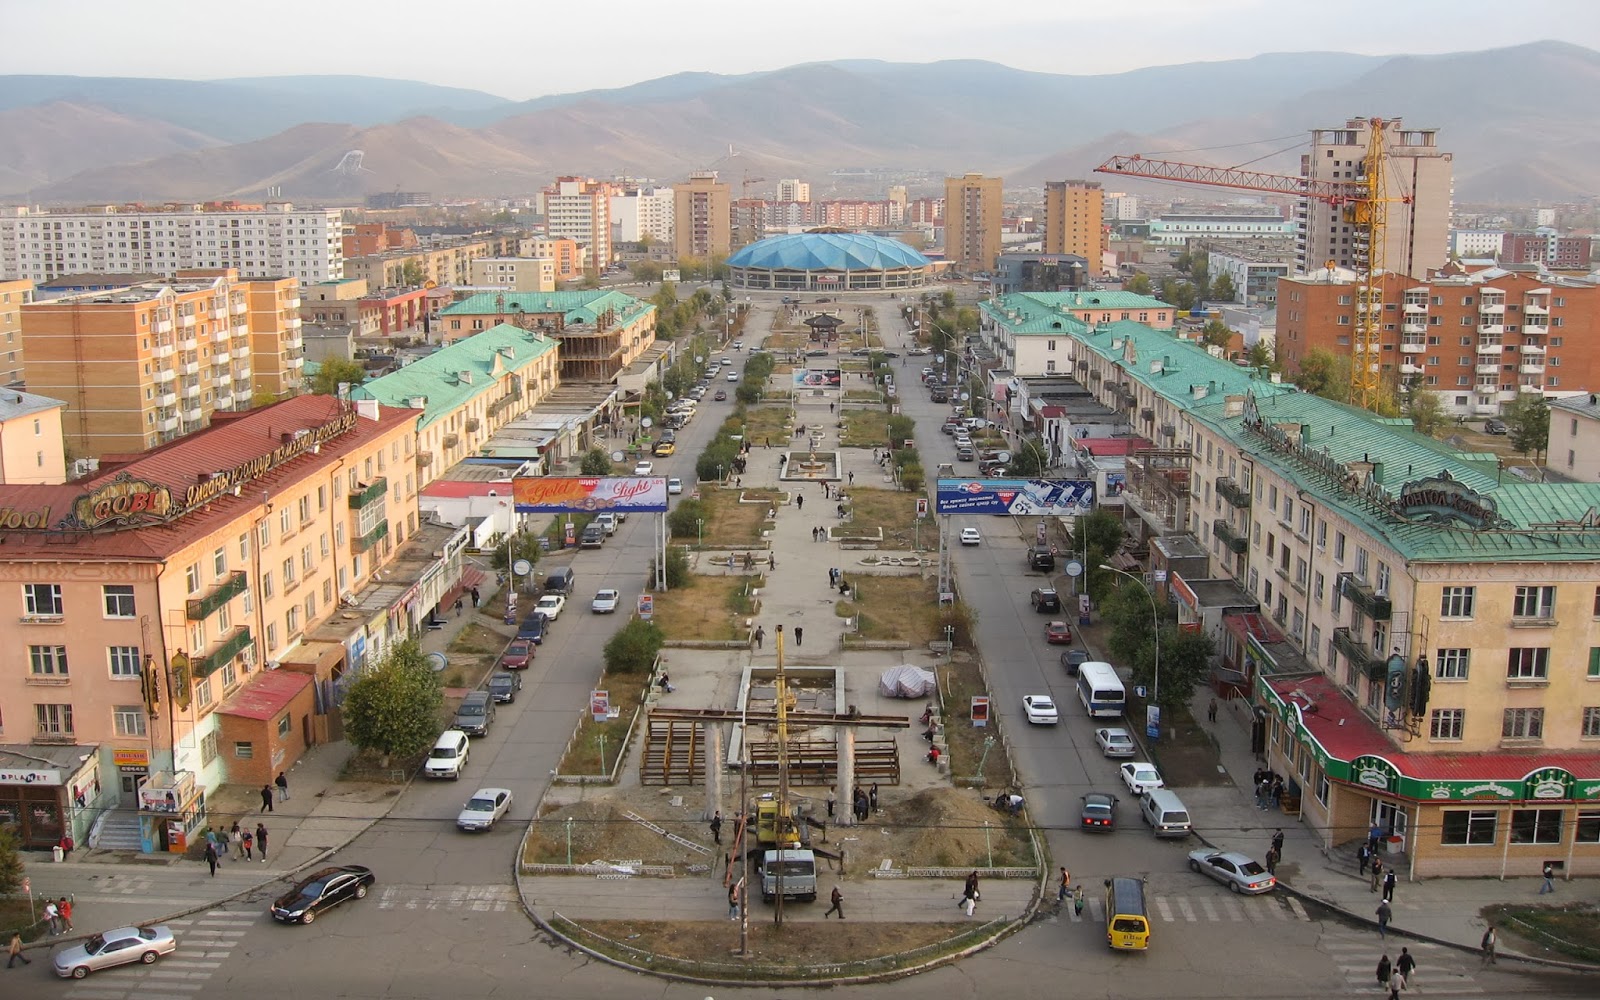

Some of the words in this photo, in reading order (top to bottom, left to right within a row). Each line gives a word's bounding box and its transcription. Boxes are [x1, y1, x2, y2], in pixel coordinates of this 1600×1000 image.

[185, 475, 229, 507] Ямааны
[231, 453, 271, 484] ноолуур
[610, 479, 653, 502] Light
[94, 491, 158, 520] GOBI
